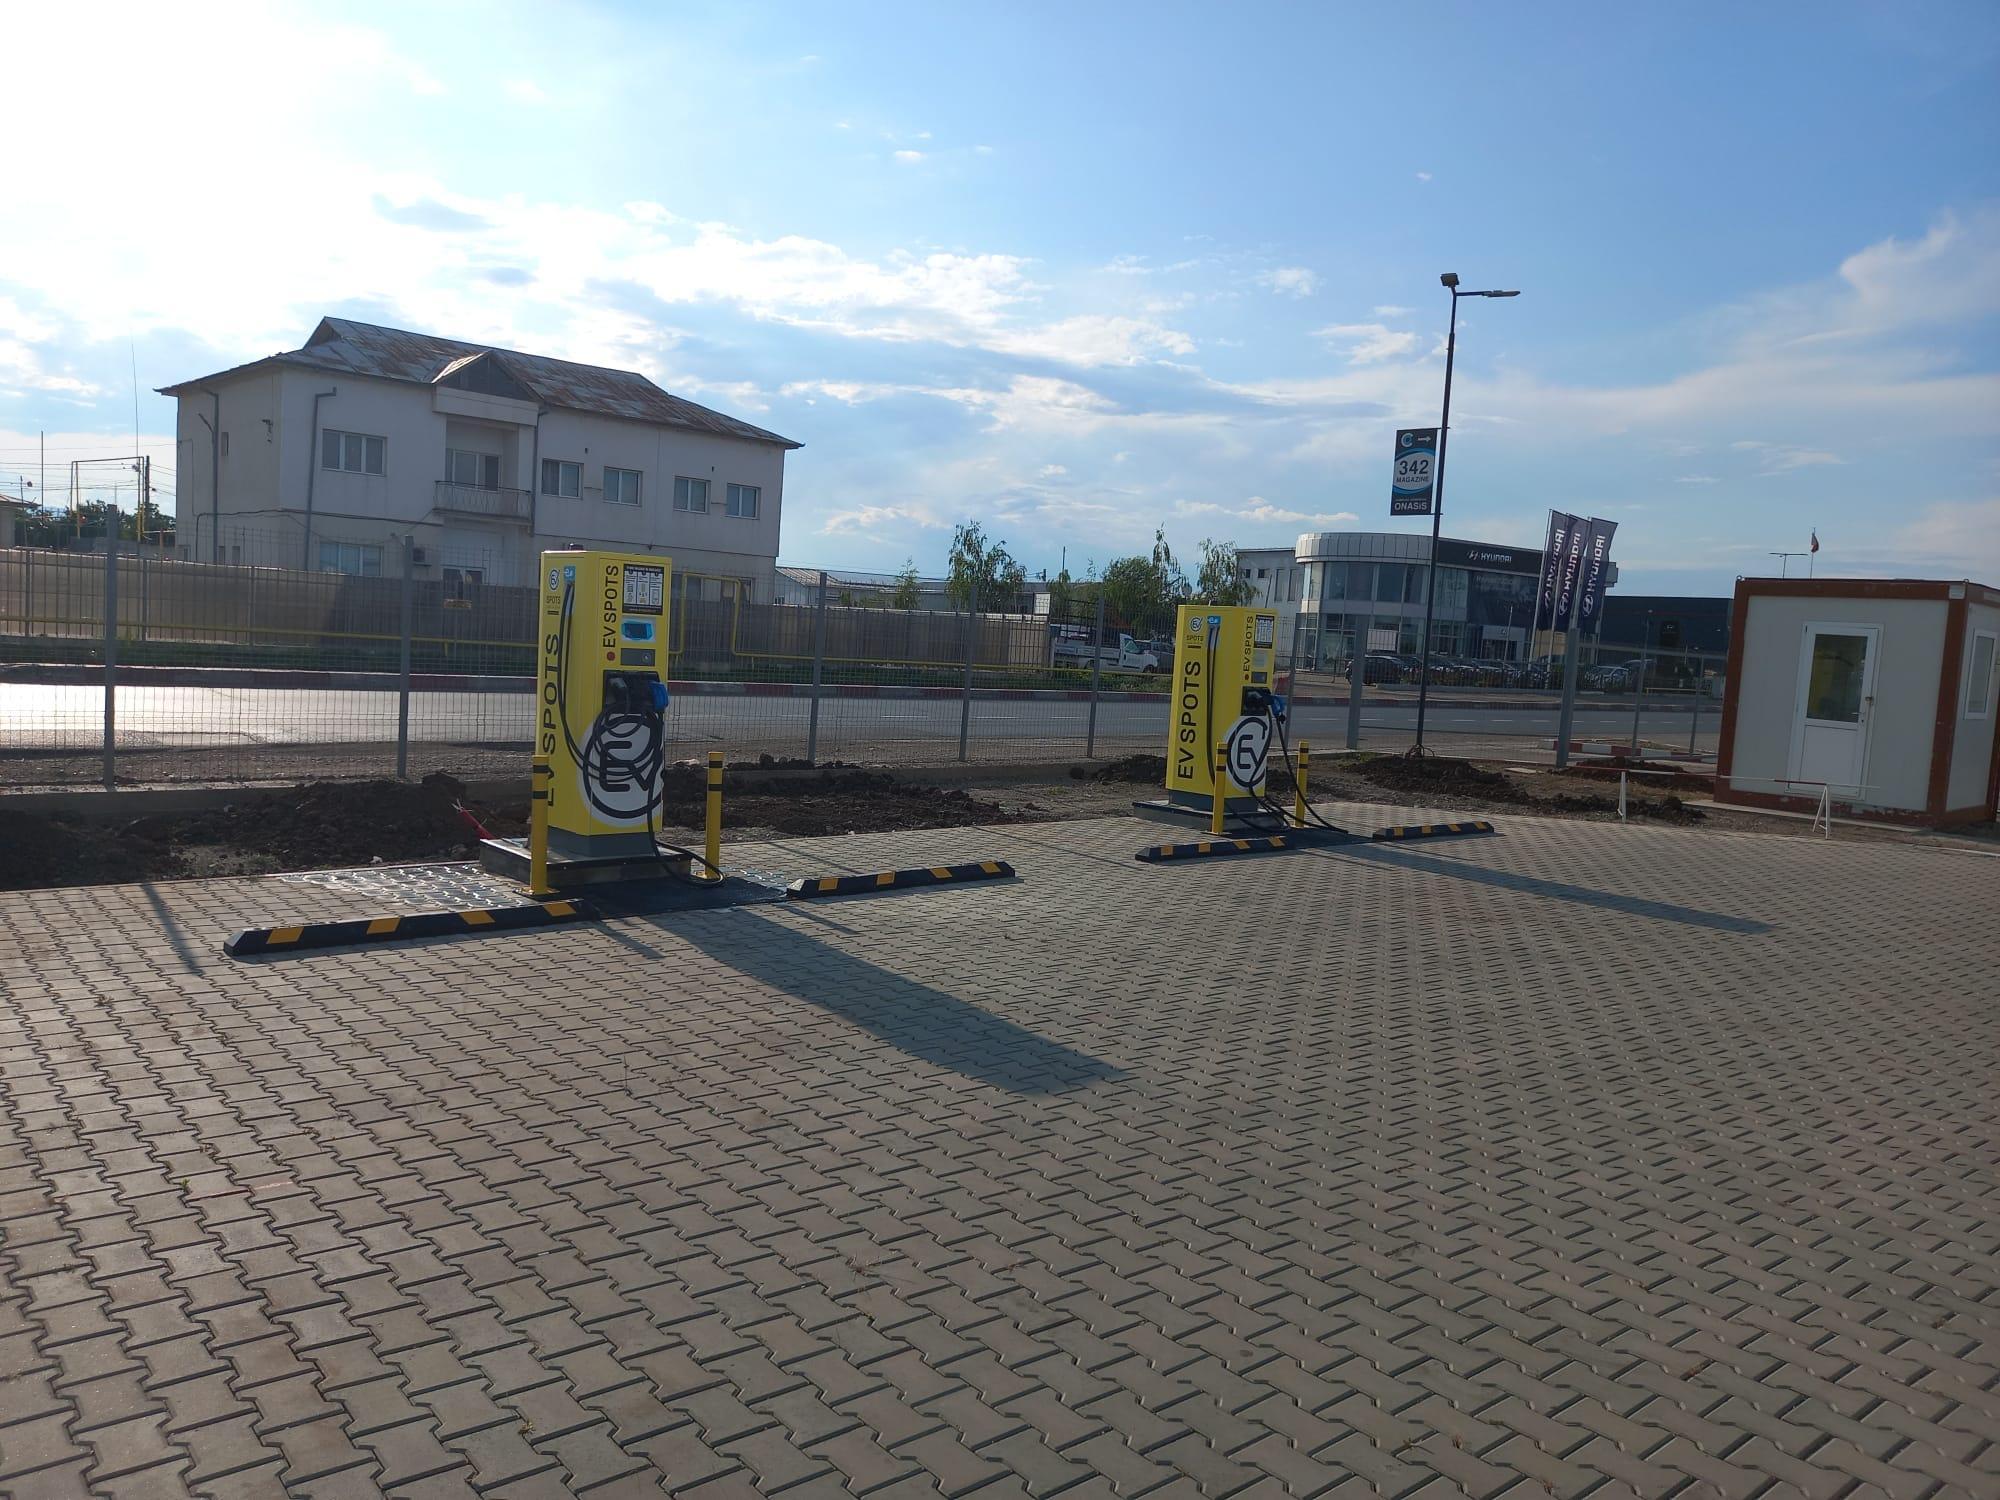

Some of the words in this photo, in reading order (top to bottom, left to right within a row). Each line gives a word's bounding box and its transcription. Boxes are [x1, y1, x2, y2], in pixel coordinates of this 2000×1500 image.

[1396, 475, 1429, 483] MAGAZINE
[1399, 459, 1429, 475] 342
[1394, 502, 1427, 511] ONASIS
[1481, 552, 1512, 563] HYUNDAI
[1564, 533, 1581, 591] HYUNDAI
[1587, 535, 1606, 592] HYUNDAI
[604, 565, 619, 623] SPOTS
[603, 626, 616, 648] EV
[543, 634, 559, 755] SPOTS
[1180, 661, 1201, 744] SPOTS
[1177, 748, 1194, 779] EV
